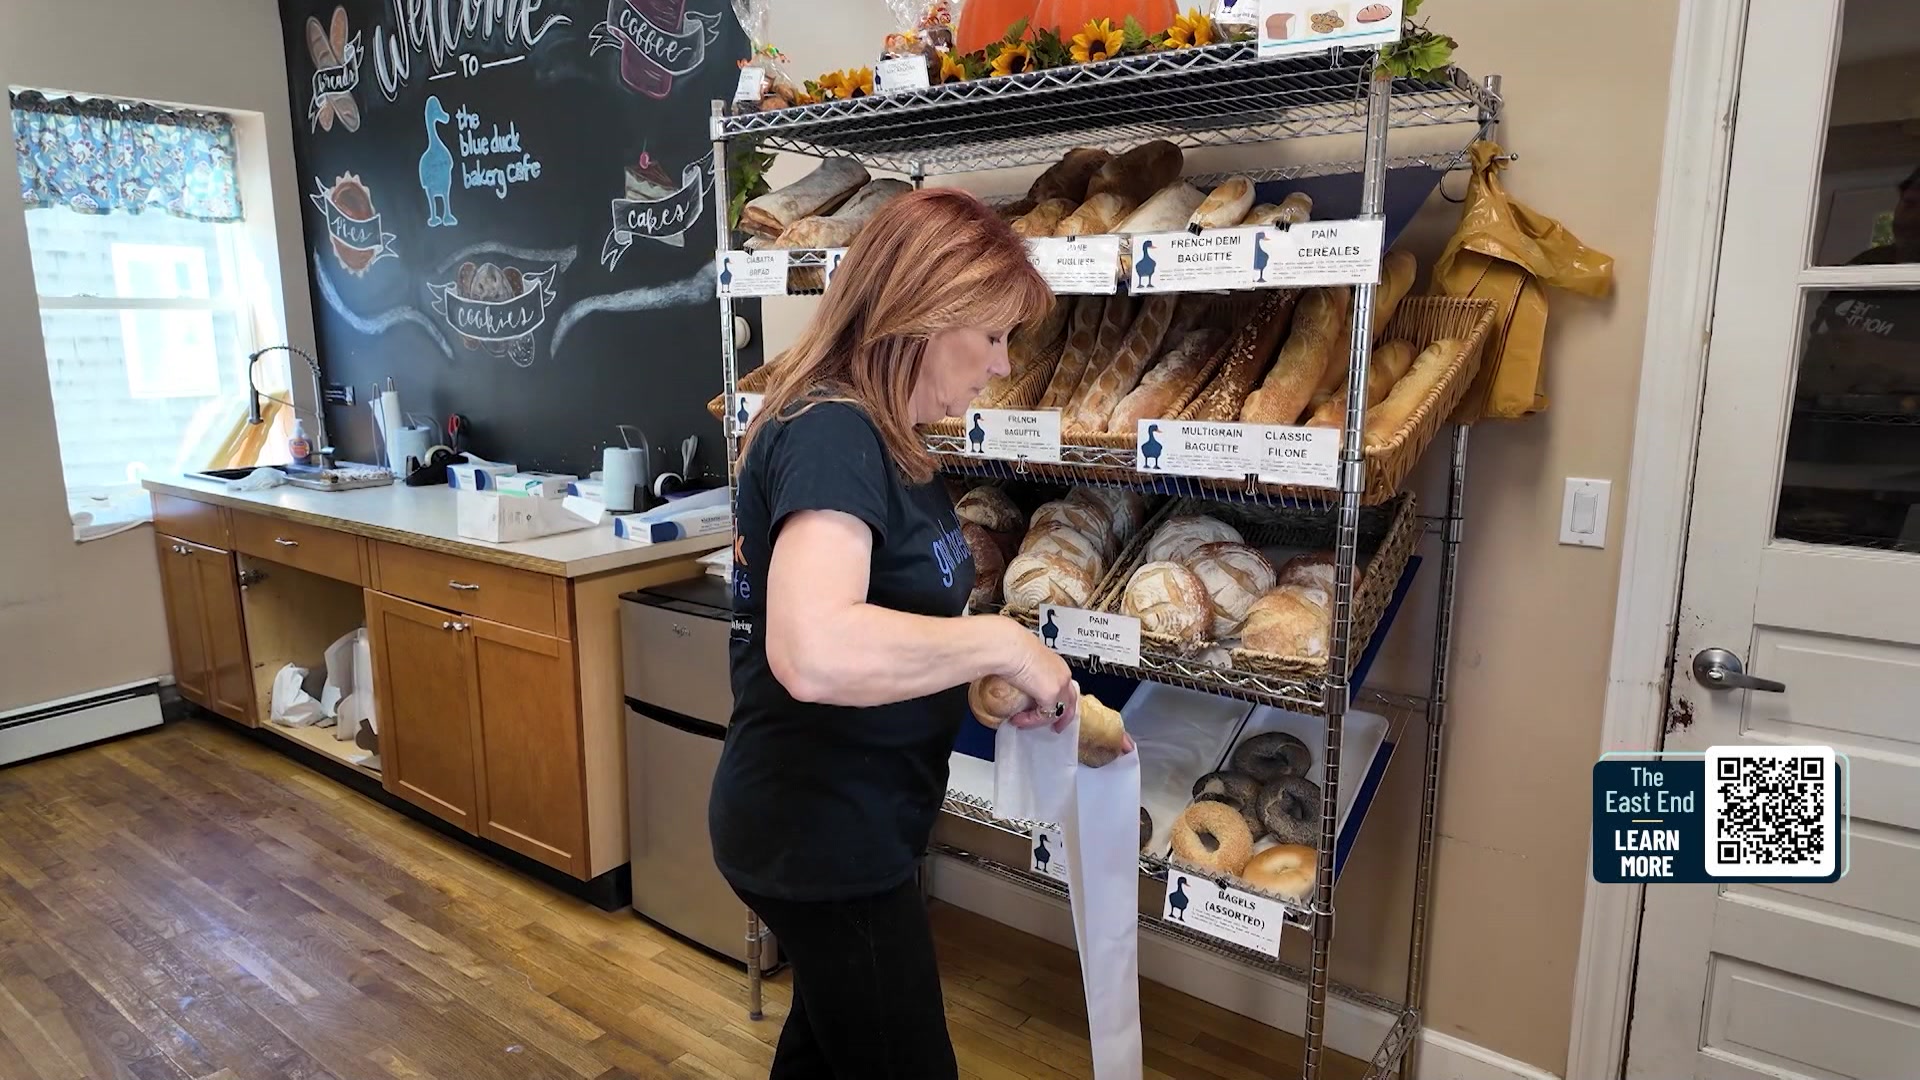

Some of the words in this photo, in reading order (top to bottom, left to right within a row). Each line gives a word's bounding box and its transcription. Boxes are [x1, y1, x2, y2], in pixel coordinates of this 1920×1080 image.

[620, 9, 692, 62] coffee
[458, 53, 480, 78] TO
[318, 66, 355, 93] breads
[455, 103, 480, 131] the
[459, 129, 489, 157] blue
[490, 121, 522, 153] duck
[506, 152, 541, 183] cafe
[628, 202, 690, 234] cakes
[1311, 228, 1338, 239] PAIN
[1171, 238, 1213, 249] FRENCH
[1215, 236, 1241, 246] DEMI
[1177, 251, 1233, 263] BAGUETTE
[1298, 245, 1360, 258] CEREALES
[458, 306, 534, 334] cookies
[1181, 426, 1243, 438] MULTIGRAIN
[1265, 431, 1313, 442] CLASSIC
[1184, 442, 1239, 454] BAGUETTE
[1268, 448, 1308, 459] FILONE
[1089, 615, 1109, 626] PAIN
[1077, 627, 1121, 642] RUSTIQUE
[1218, 890, 1256, 910] BAGELS
[1205, 901, 1265, 931] (ASSORTED)
